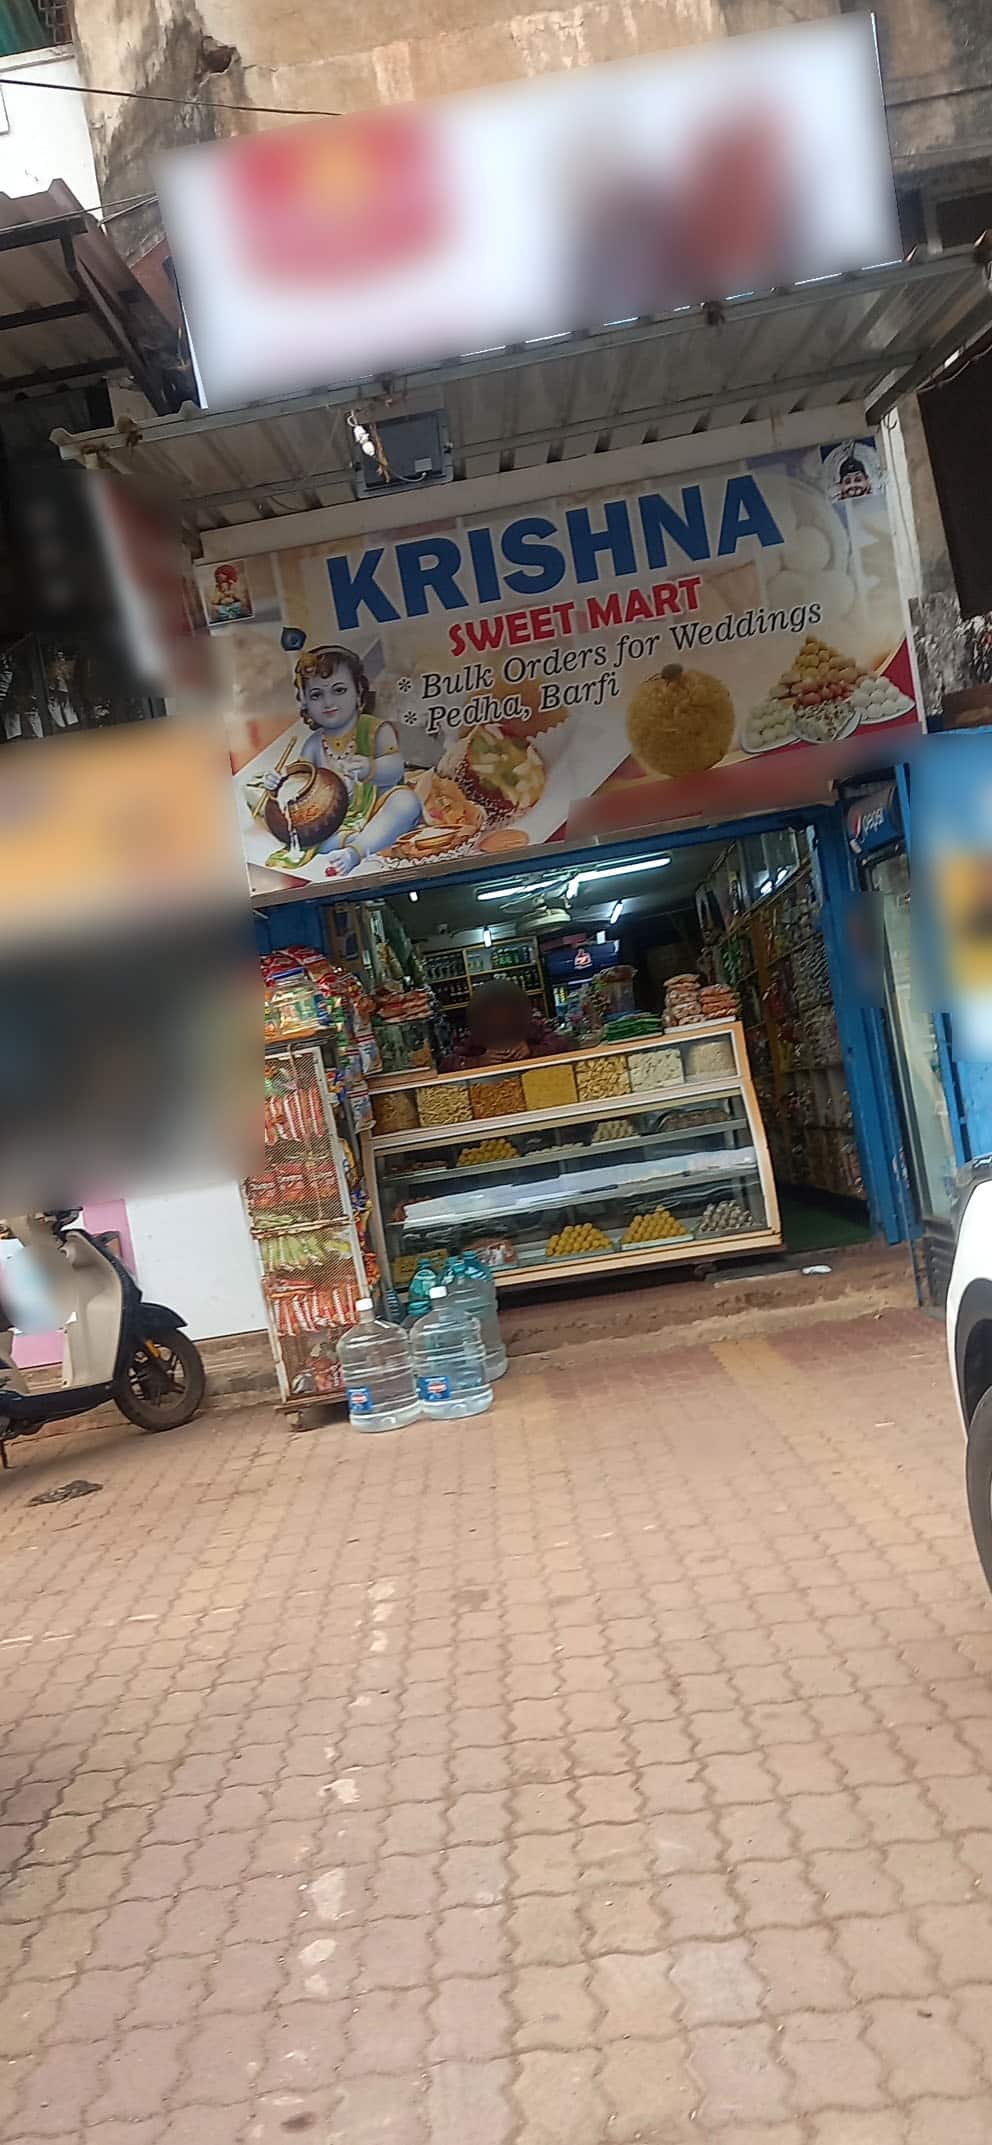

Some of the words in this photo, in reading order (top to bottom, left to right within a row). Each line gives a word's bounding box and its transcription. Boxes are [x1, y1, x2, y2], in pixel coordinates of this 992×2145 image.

[326, 475, 784, 630] KRISHNA
[422, 664, 493, 699] Bulk
[504, 645, 607, 682] Orders
[614, 634, 660, 668] for
[669, 603, 821, 650] Weddings
[448, 602, 575, 657] SWEET
[589, 577, 702, 629] MART
[426, 695, 531, 733] Pedha,
[540, 670, 620, 711] Barfi
